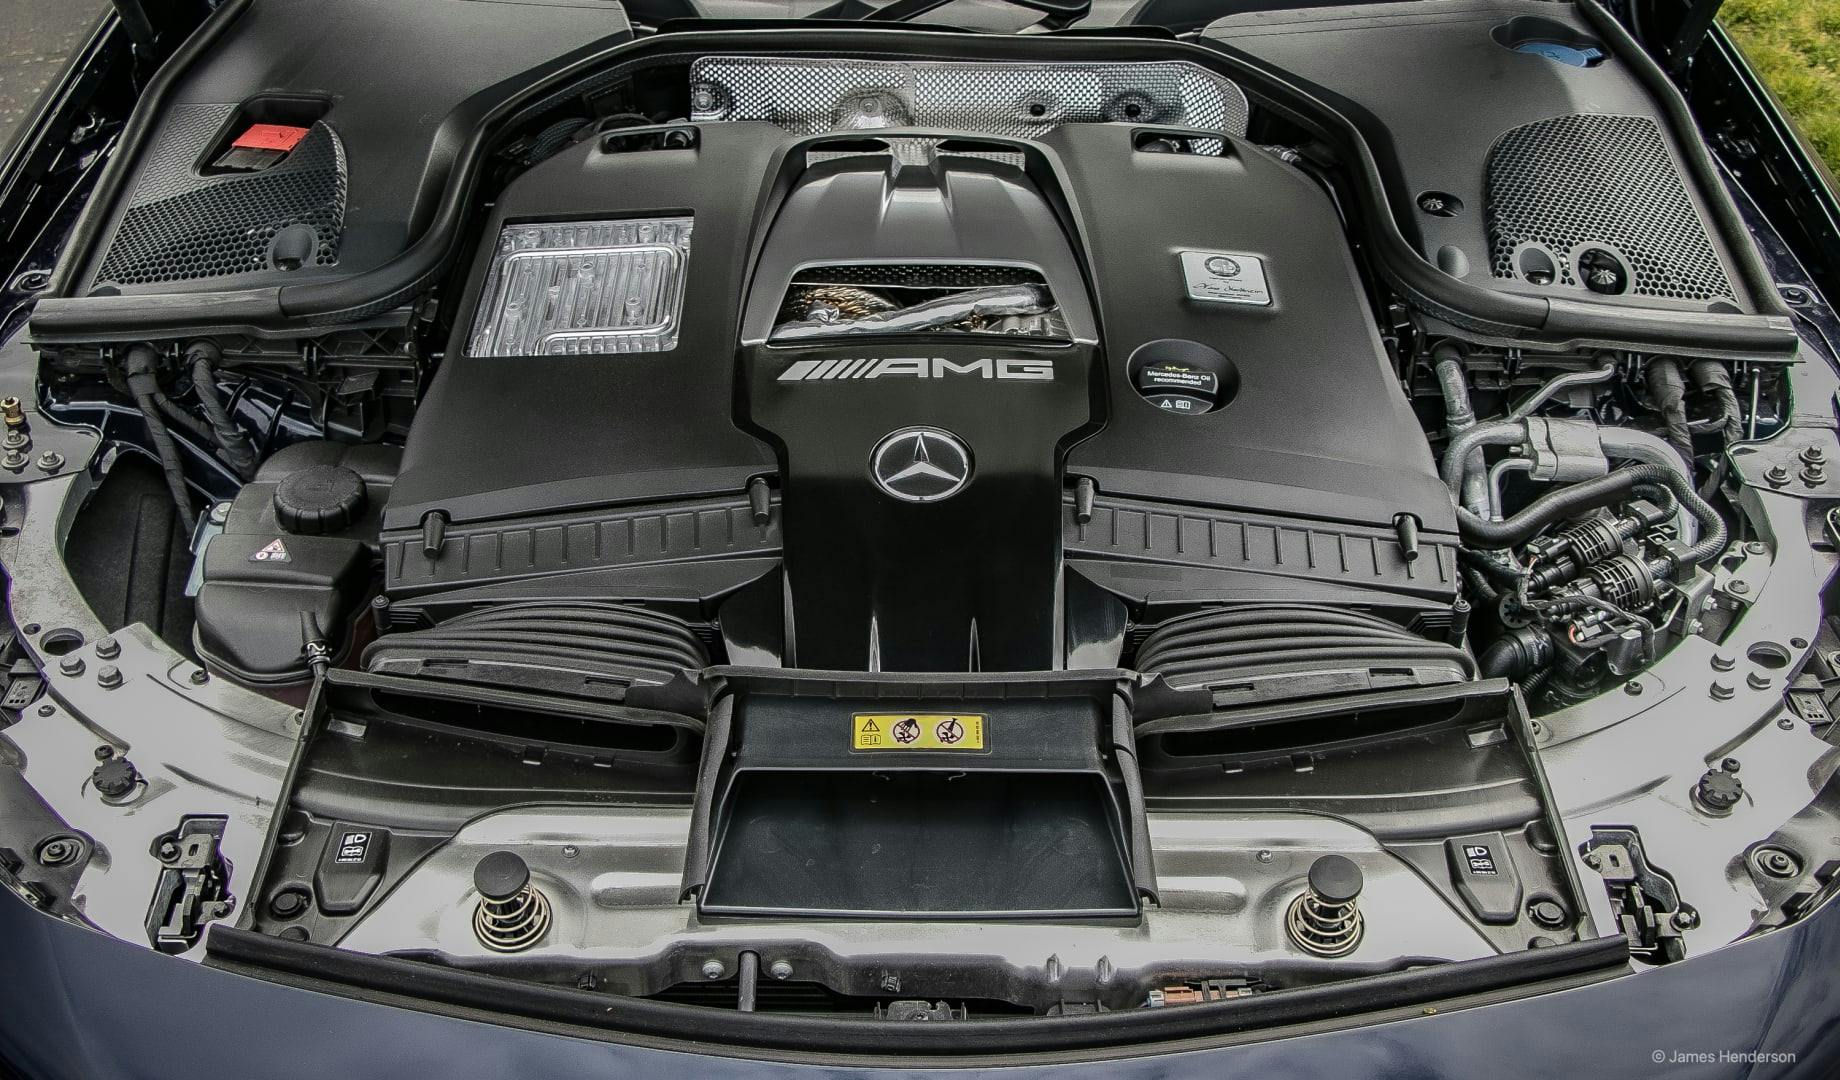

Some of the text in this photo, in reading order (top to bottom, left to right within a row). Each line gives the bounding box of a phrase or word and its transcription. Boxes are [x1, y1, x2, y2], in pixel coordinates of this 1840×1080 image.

[864, 357, 1054, 380] AMG
[1147, 371, 1200, 380] Mercedes-Benz
[1154, 377, 1202, 386] recommended
